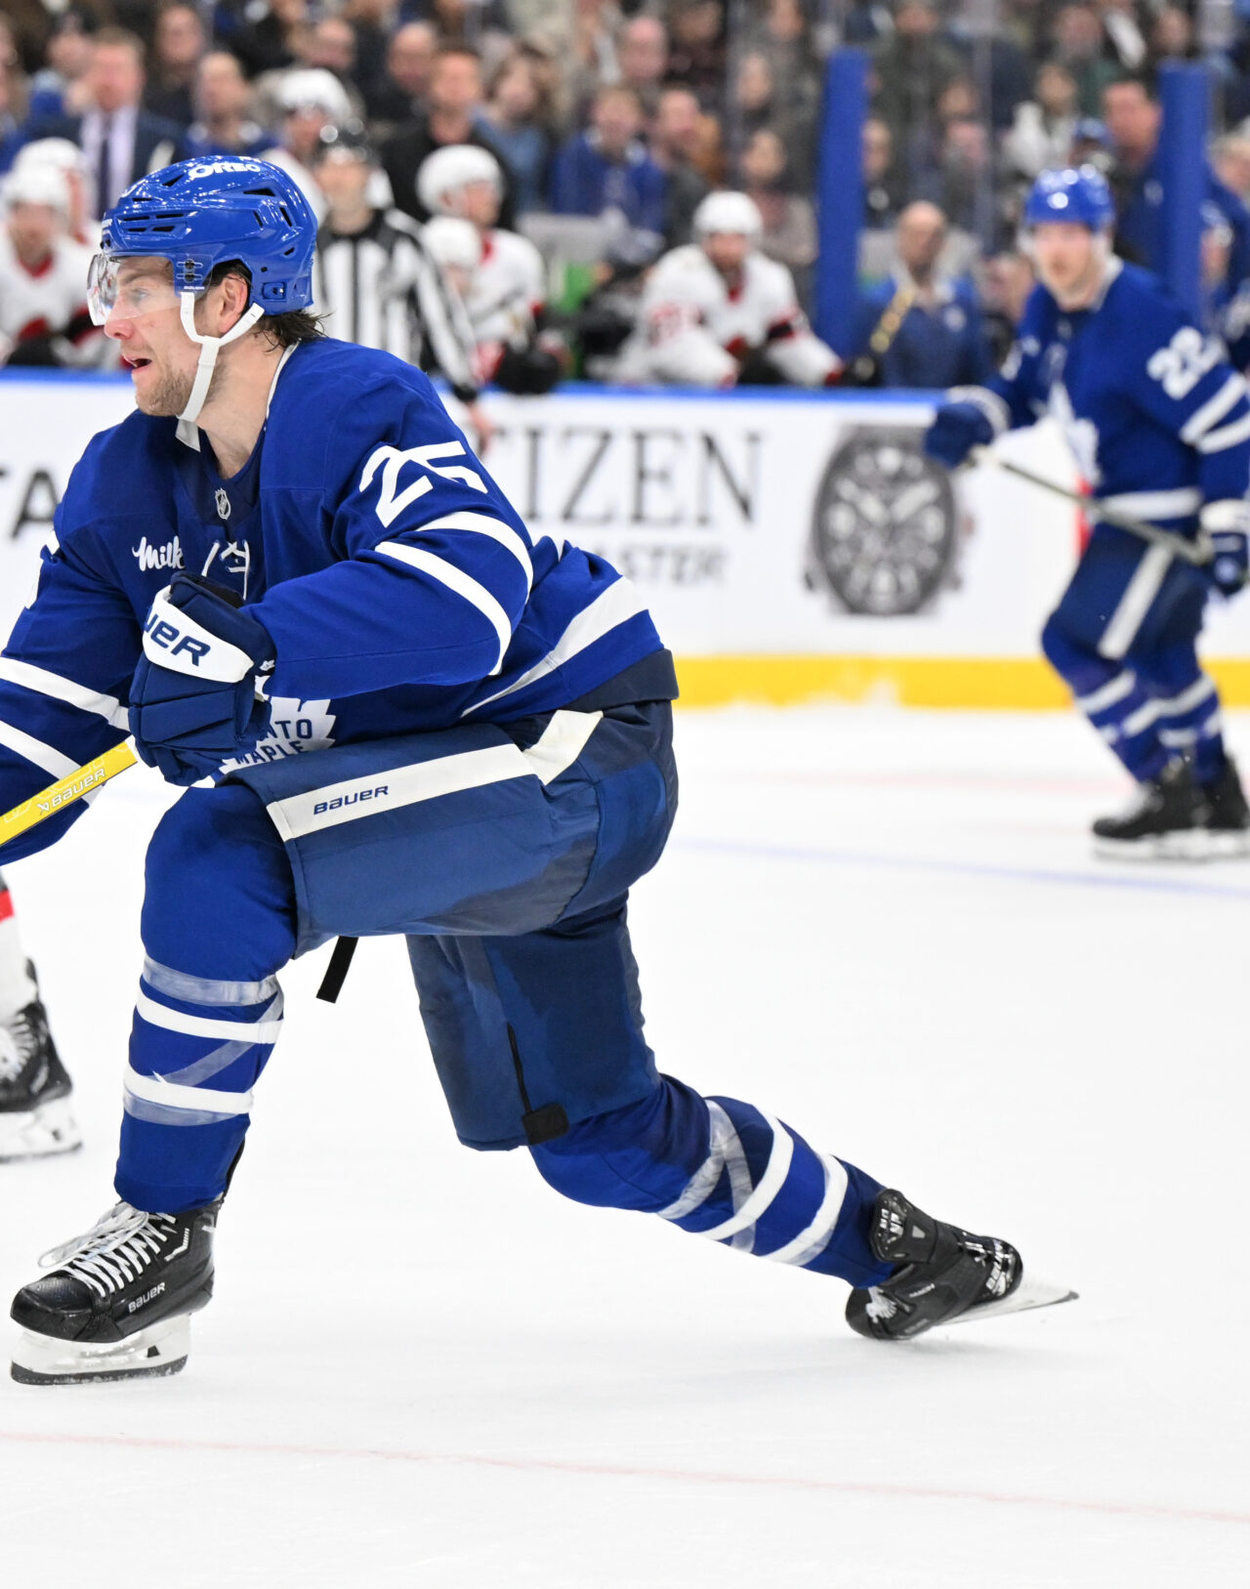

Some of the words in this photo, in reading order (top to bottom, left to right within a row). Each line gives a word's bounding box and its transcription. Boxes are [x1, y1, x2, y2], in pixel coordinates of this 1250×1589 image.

[188, 161, 261, 178] OREO
[1146, 325, 1231, 401] 22
[359, 440, 489, 528] 25
[494, 424, 763, 523] IZEN
[132, 535, 185, 571] Milk
[144, 606, 211, 667] UER
[51, 767, 106, 808] BAUER
[314, 785, 389, 815] BAUER
[128, 1282, 166, 1313] BAUER
